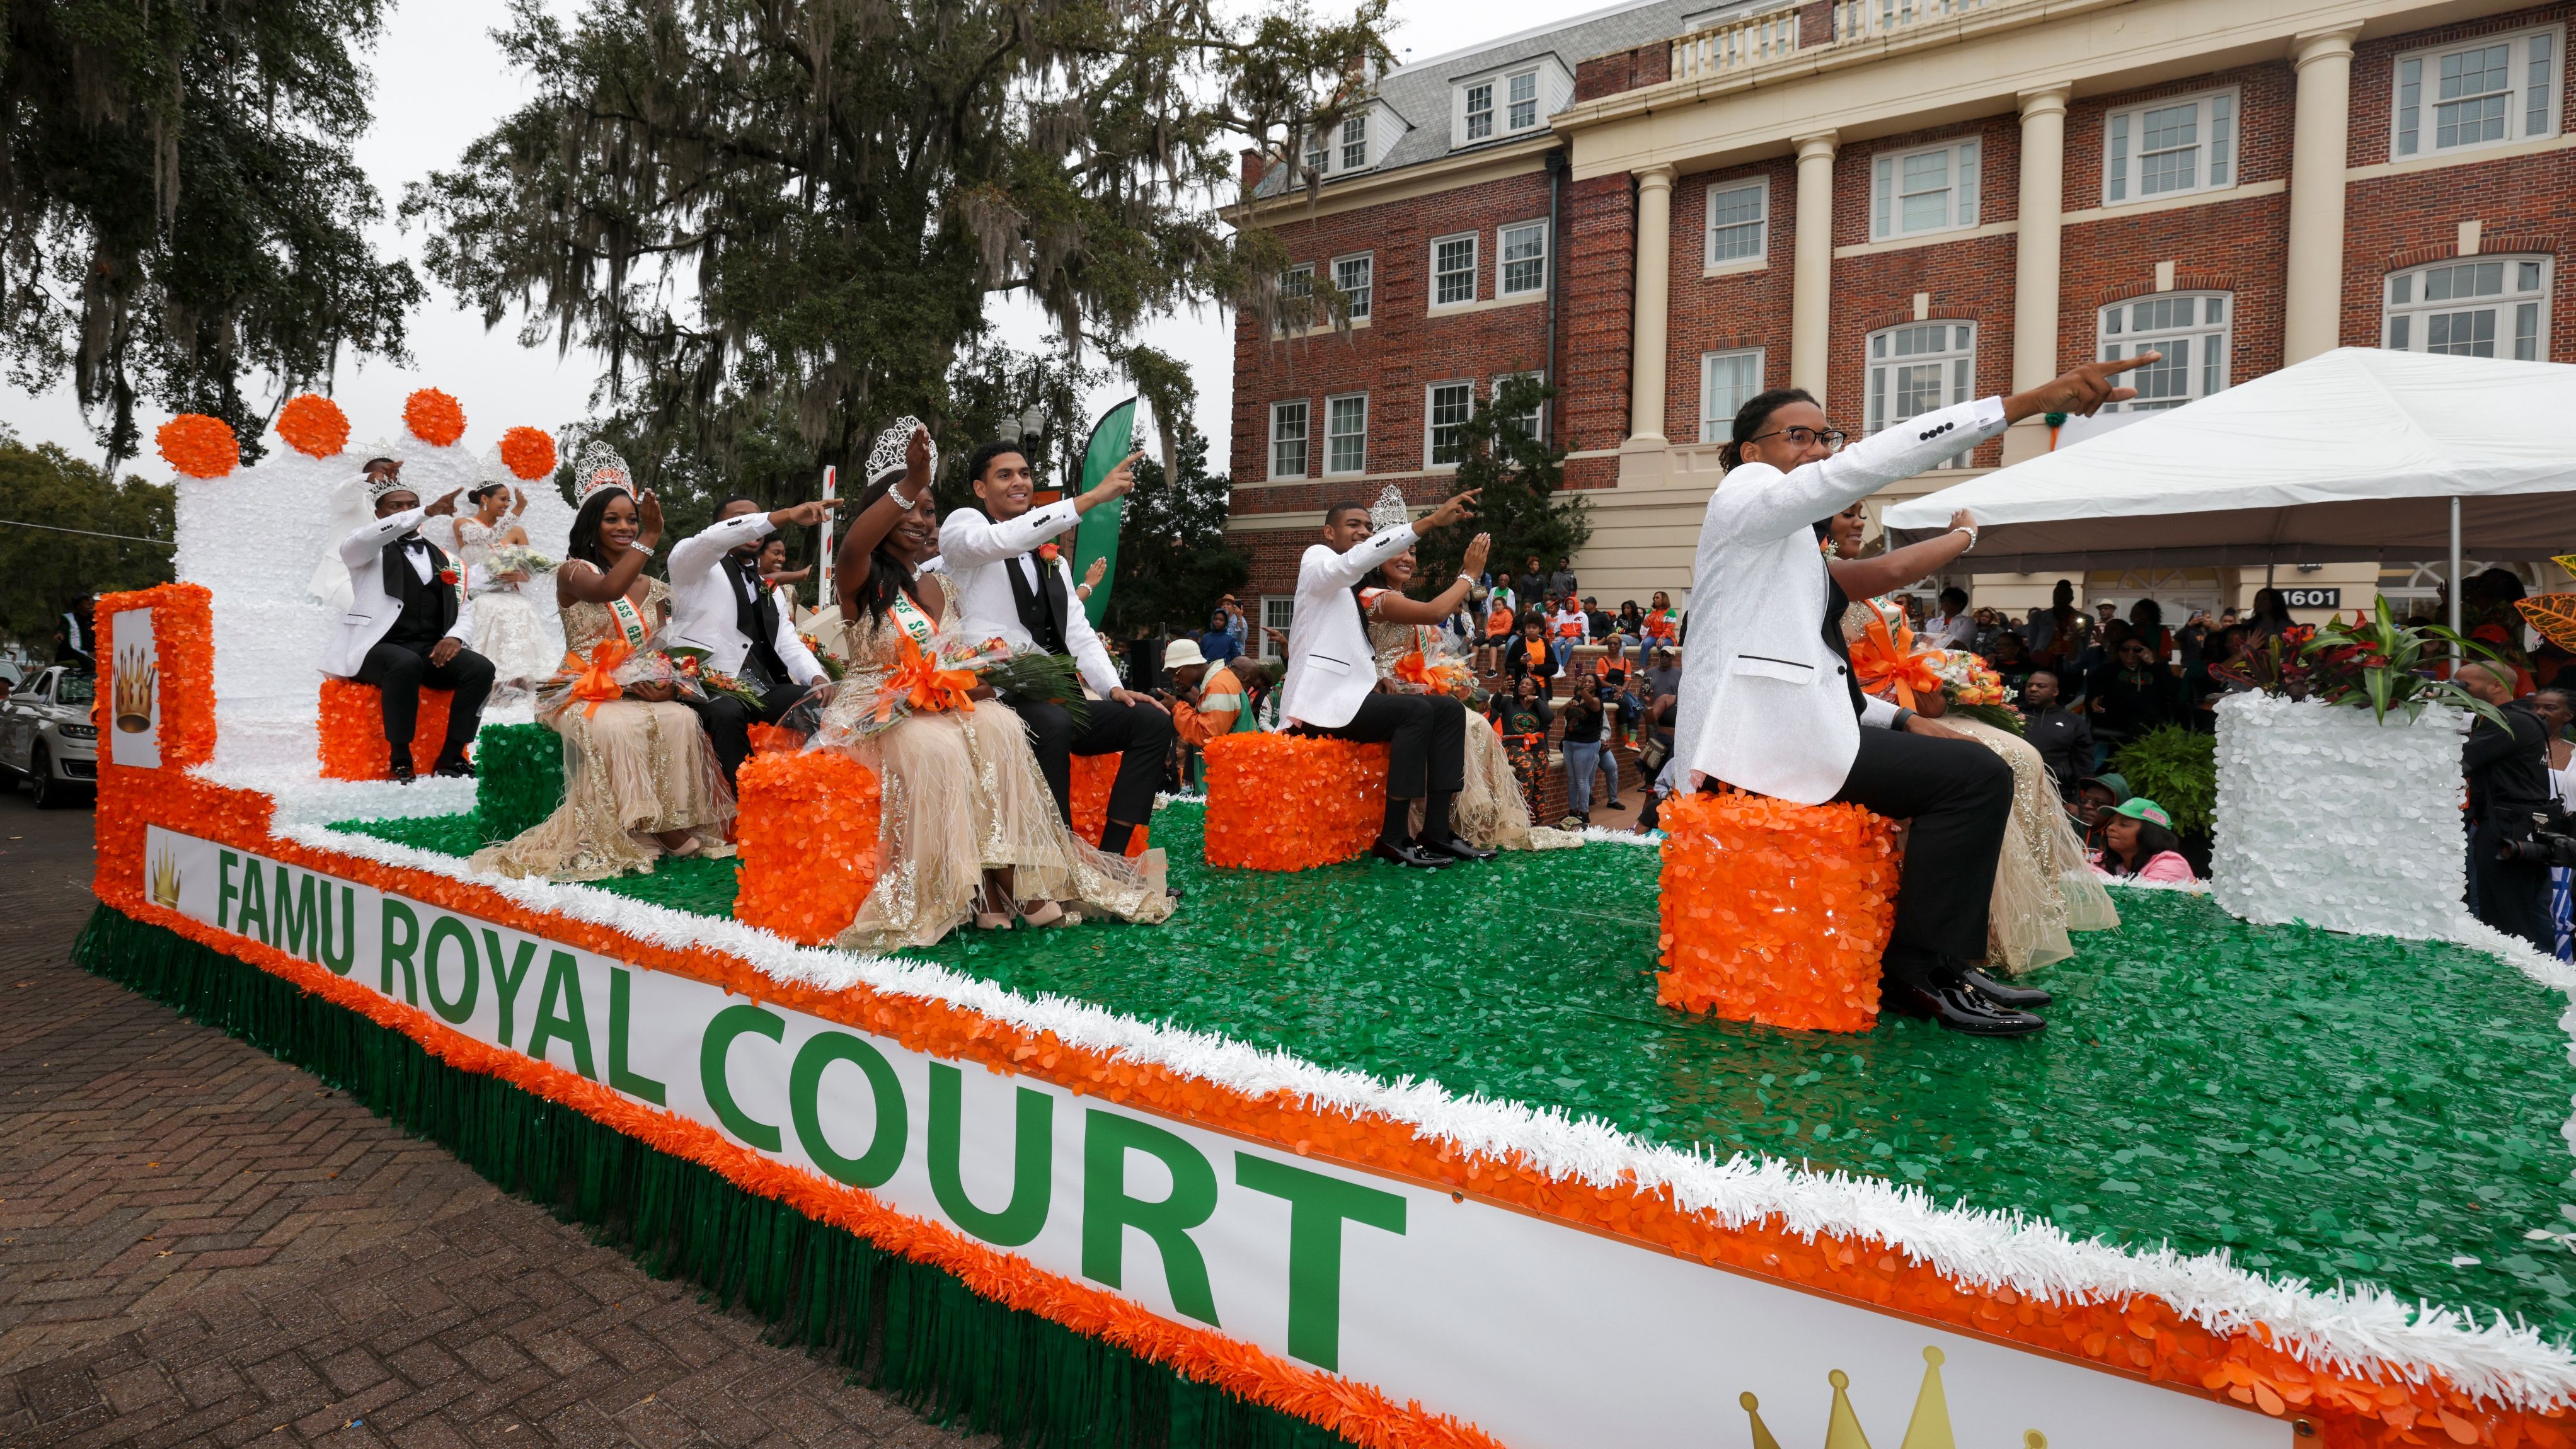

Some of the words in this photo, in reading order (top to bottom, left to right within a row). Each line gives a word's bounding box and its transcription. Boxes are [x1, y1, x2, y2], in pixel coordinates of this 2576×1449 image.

[2282, 591, 2335, 605] 1601
[614, 599, 633, 618] ISS
[217, 848, 354, 976] FAMU
[381, 898, 666, 1107] ROYAL
[699, 1004, 1406, 1373] COURT
